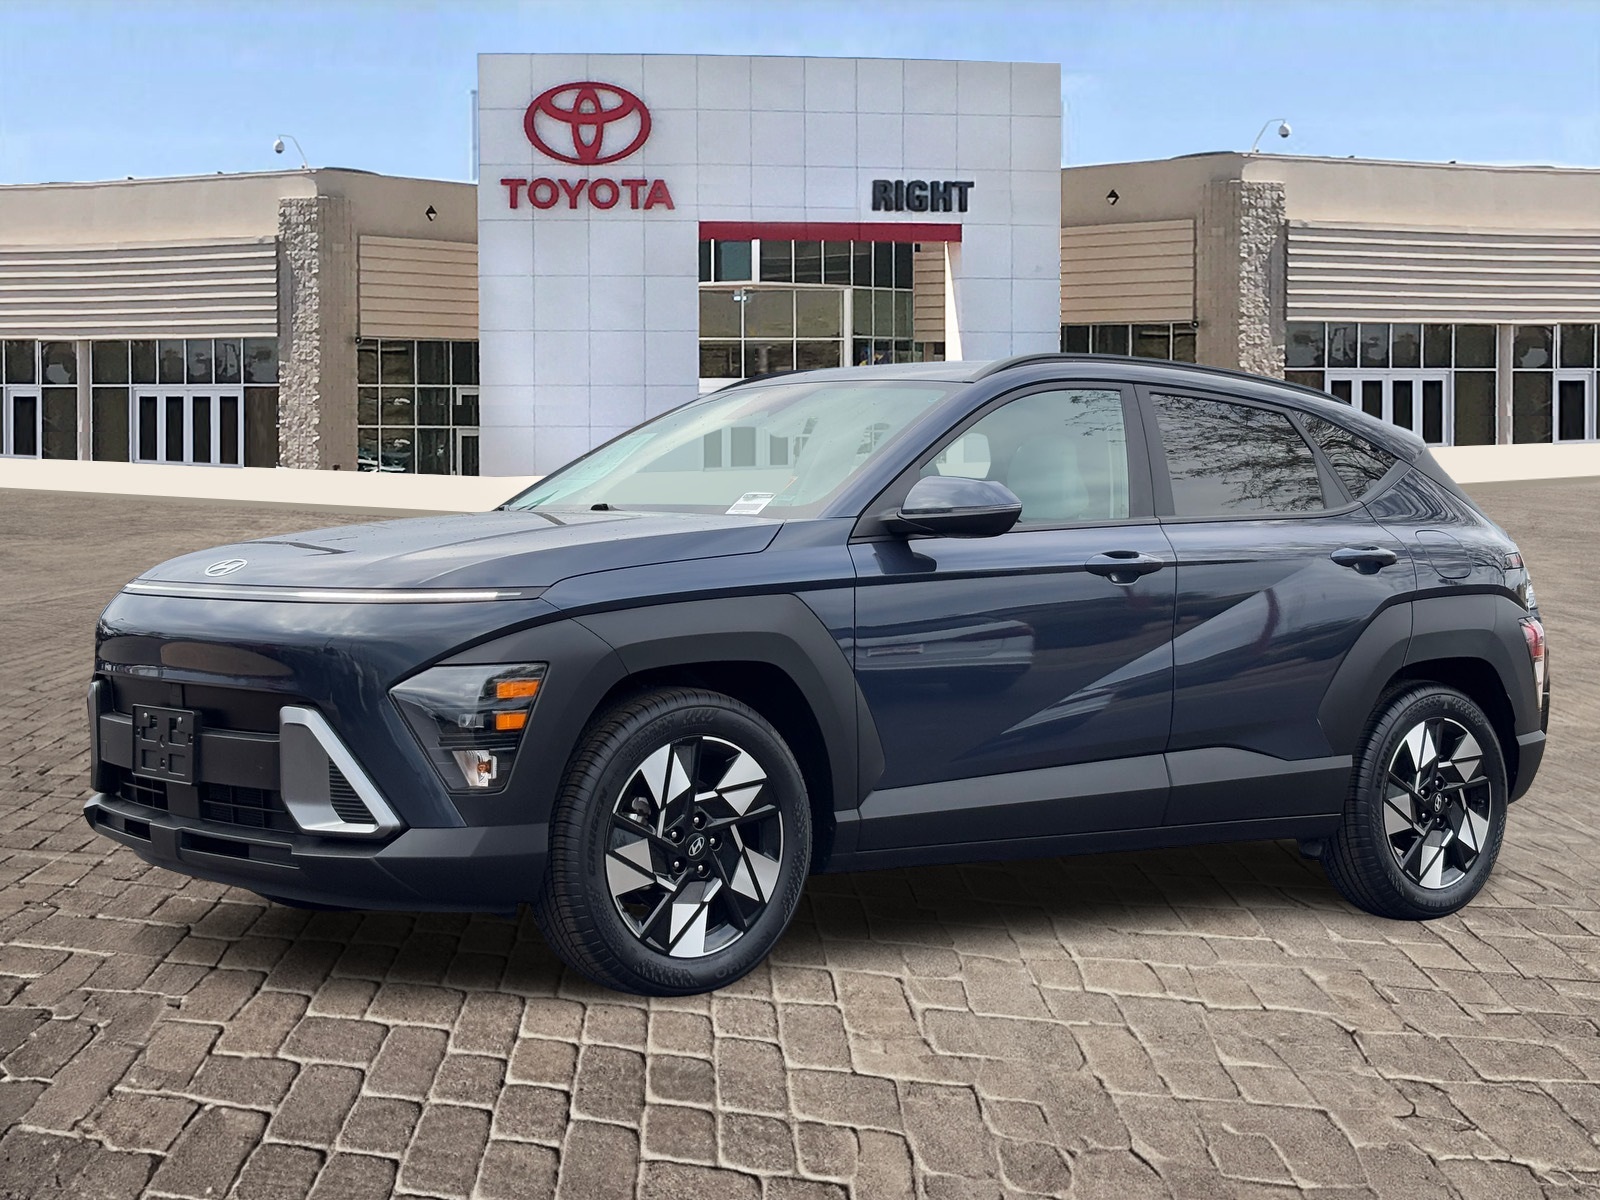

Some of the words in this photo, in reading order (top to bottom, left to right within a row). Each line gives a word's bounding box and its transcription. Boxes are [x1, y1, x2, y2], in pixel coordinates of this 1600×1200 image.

[500, 177, 675, 210] TOYOTA
[871, 179, 975, 213] RIGHT
[1375, 731, 1399, 789] KUMHO
